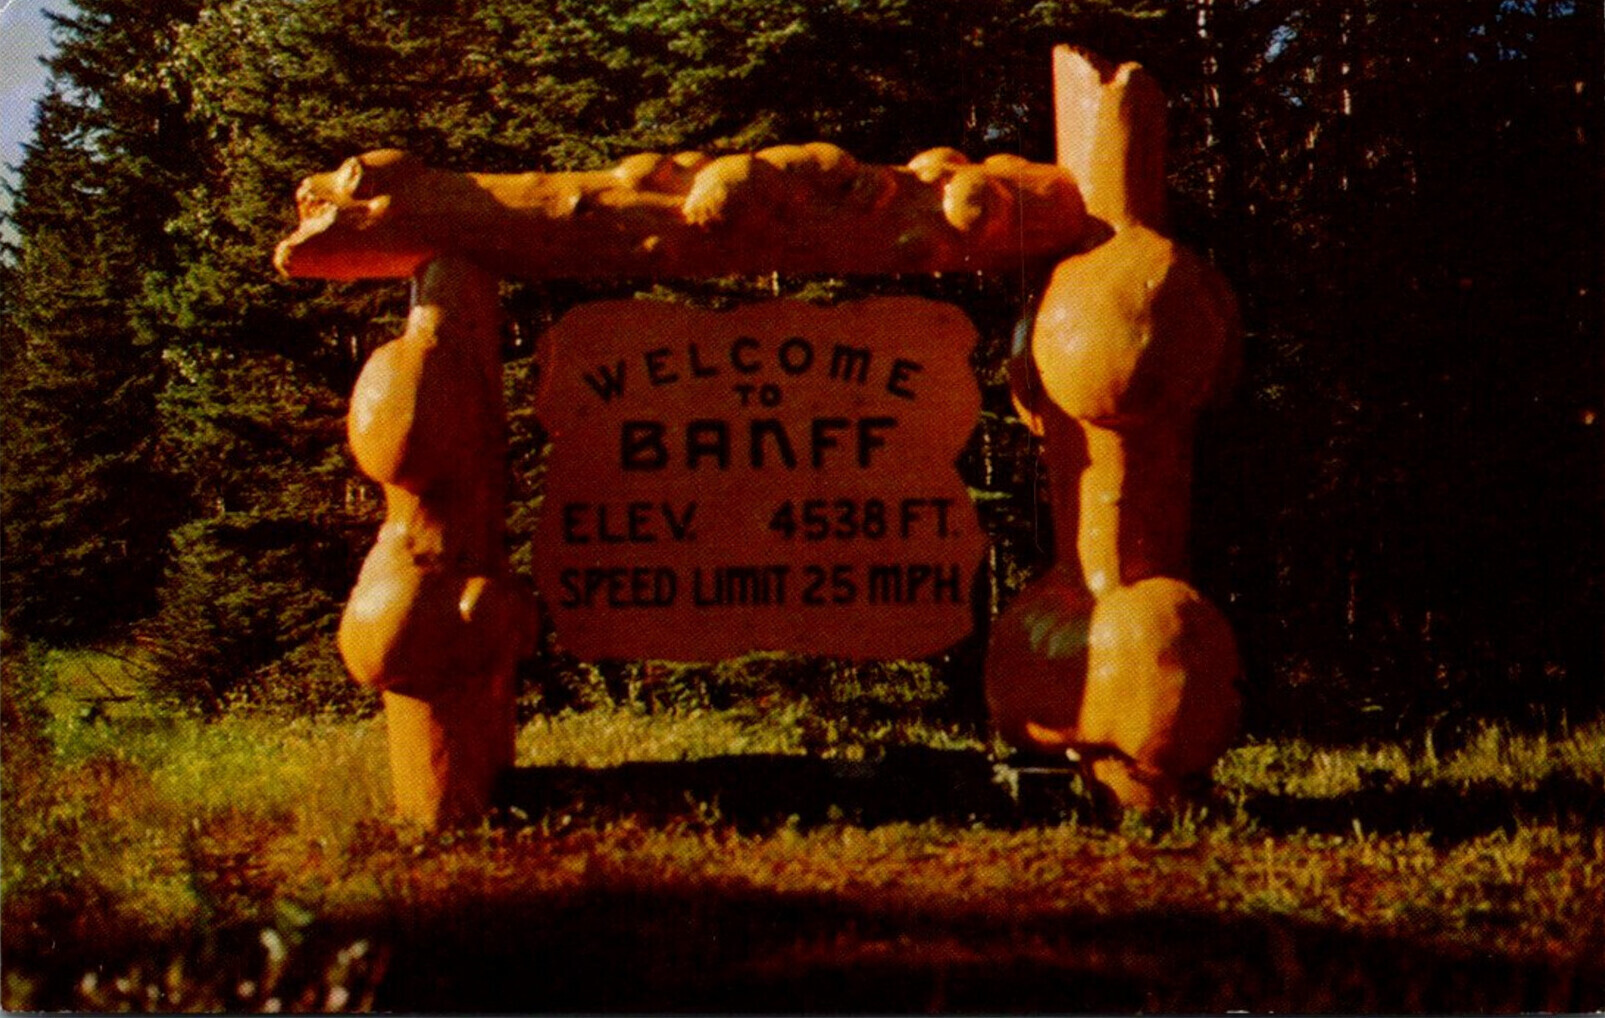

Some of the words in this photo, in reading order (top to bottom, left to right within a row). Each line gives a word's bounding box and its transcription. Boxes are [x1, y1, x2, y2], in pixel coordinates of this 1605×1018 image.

[582, 336, 924, 401] WELCOME
[733, 384, 782, 408] TO
[619, 417, 897, 472] BANFF
[769, 499, 886, 542] 4538
[559, 566, 677, 609] SPEED
[694, 565, 790, 607] LIMIT
[801, 564, 857, 606] 25
[868, 564, 960, 607] MPH
